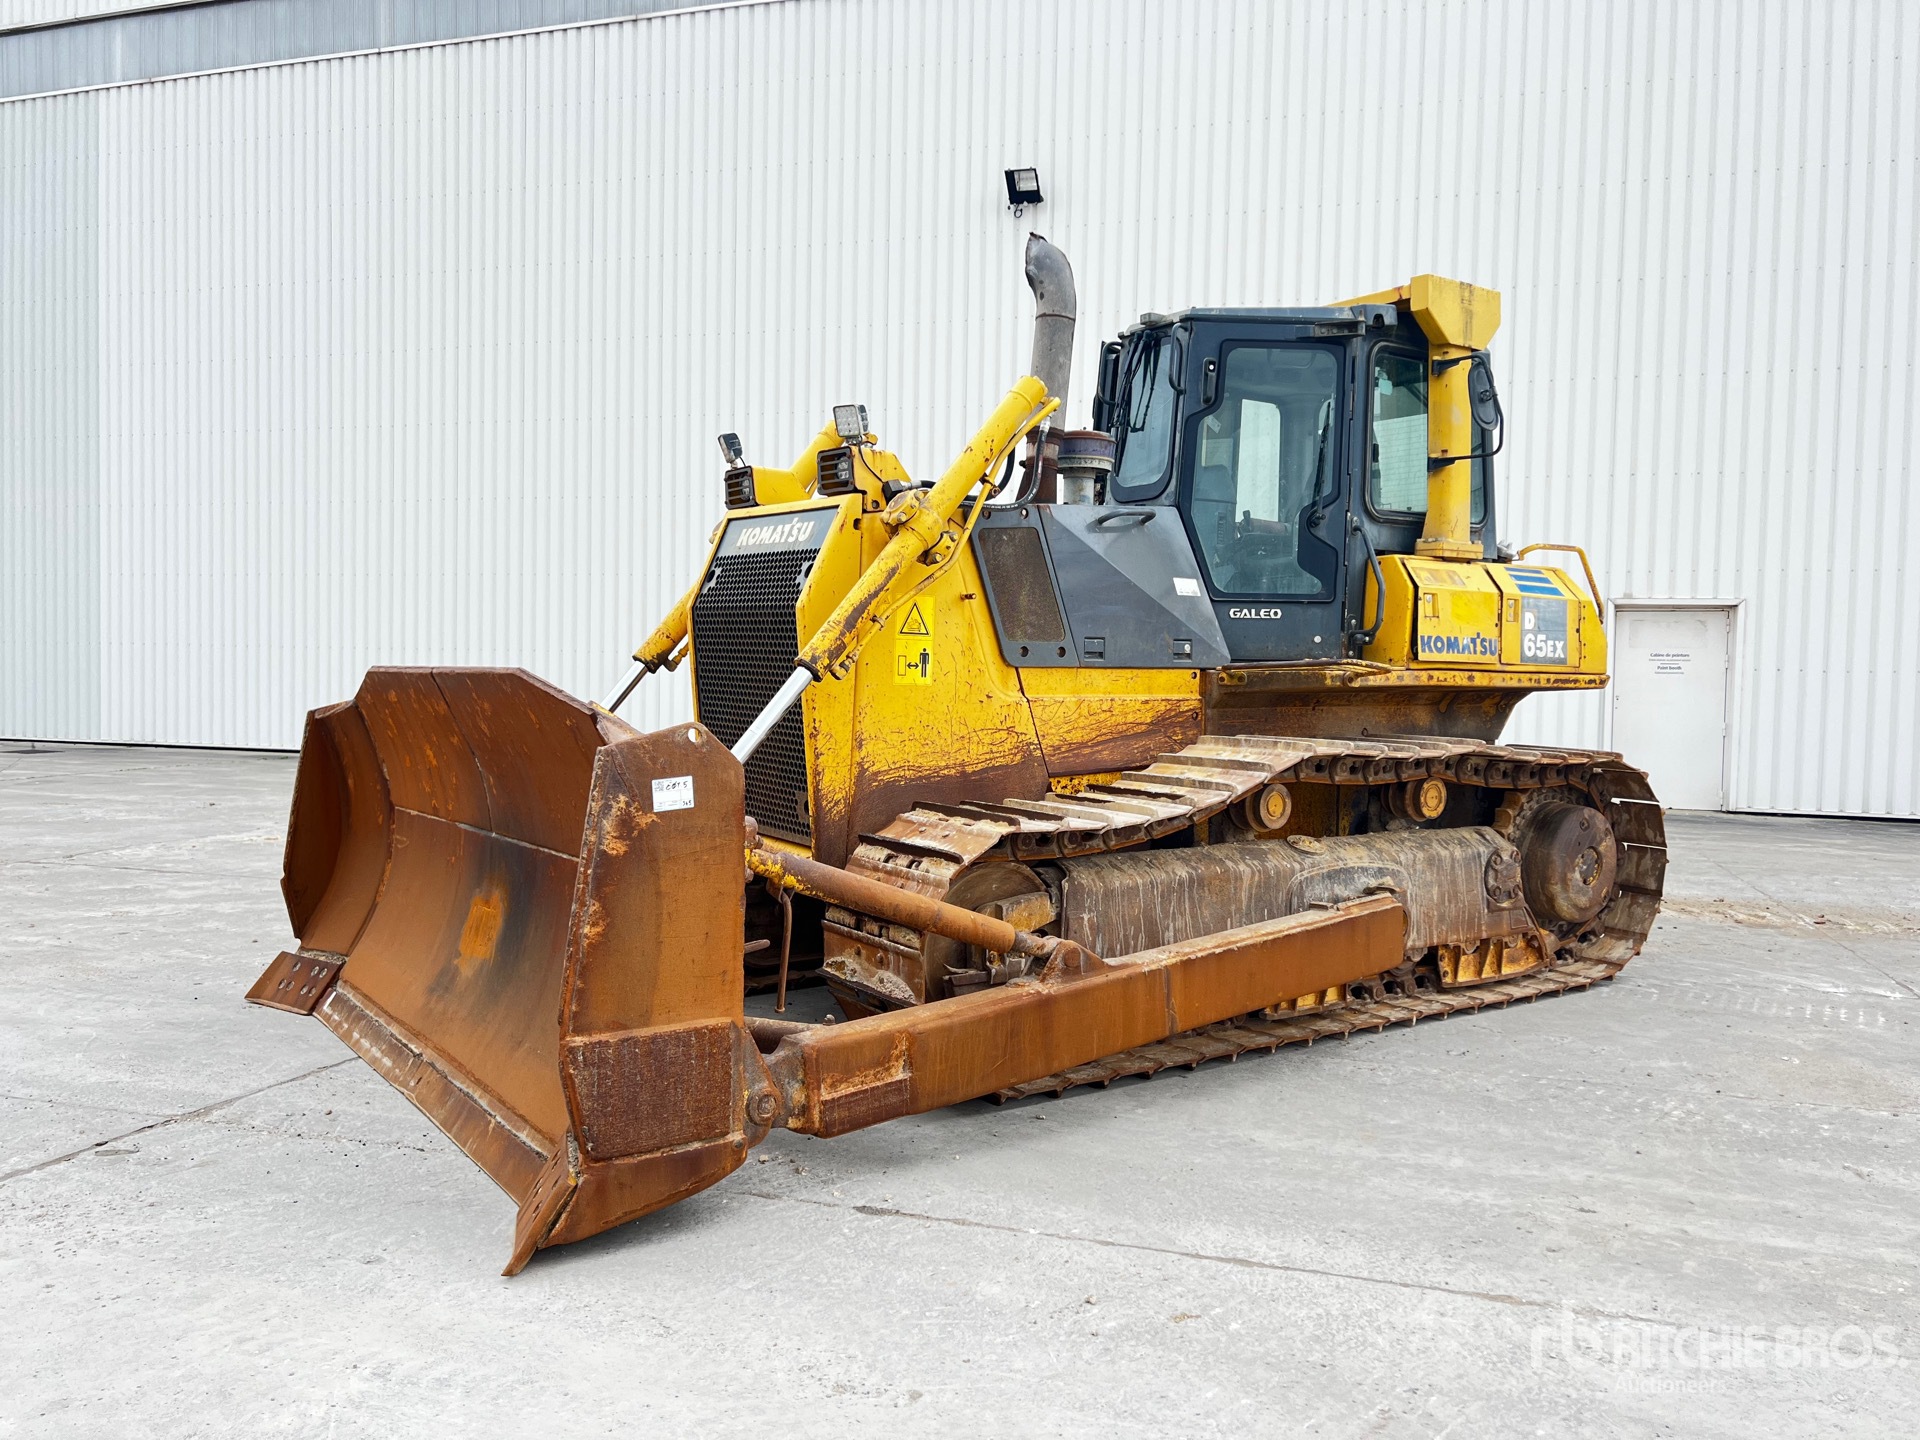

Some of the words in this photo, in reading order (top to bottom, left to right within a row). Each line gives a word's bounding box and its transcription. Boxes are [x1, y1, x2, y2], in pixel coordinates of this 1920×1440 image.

[736, 517, 815, 547] KOMATSU
[1229, 608, 1282, 619] GALEO
[1524, 611, 1535, 630] D
[1420, 632, 1498, 656] KOMATSU
[1523, 633, 1565, 658] 65EX
